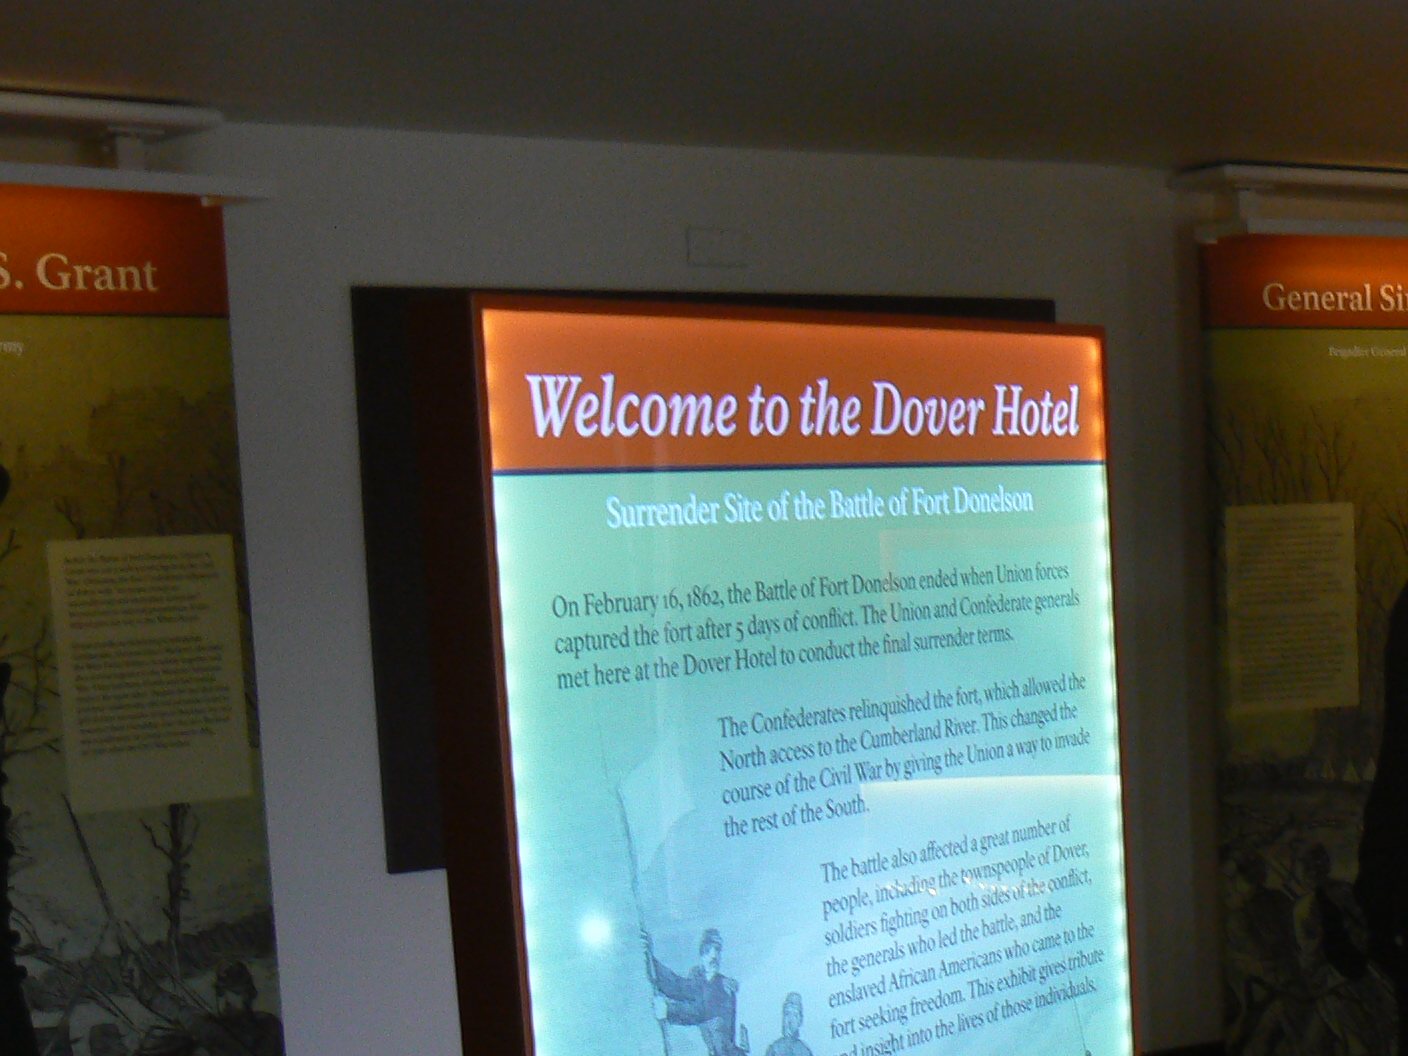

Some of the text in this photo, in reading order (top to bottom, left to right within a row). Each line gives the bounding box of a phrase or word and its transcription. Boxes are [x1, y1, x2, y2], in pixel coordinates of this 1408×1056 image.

[36, 252, 159, 292] Grant
[1262, 282, 1373, 312] General
[525, 372, 1080, 439] Welcome to the Dover Hotel
[607, 485, 1034, 528] Surrender Site of the Battle of Fort Donelson
[552, 561, 1070, 617] On February 16, 1862, the Battle of Fort Donelson ended when Union forces
[554, 587, 1081, 659] captured the fort after 5 days of conflict. The Union and Confederate generals
[557, 626, 1015, 689] met here at the Dover Hotel to conduct the final surrender terms.
[718, 672, 1086, 738] The Confederates relinquished the fort, which allowed the
[719, 701, 1078, 771] North access to the Cumberland River. This changed the
[722, 727, 1090, 804] course of the Civil War by giving the Union a way to invade
[724, 793, 870, 837] the rest of the South.
[821, 814, 1071, 883] The battle also affected a great number of
[826, 903, 1062, 977] the generals who led the battle, and the
[829, 923, 1095, 1008] enslaved African Americans who came to the
